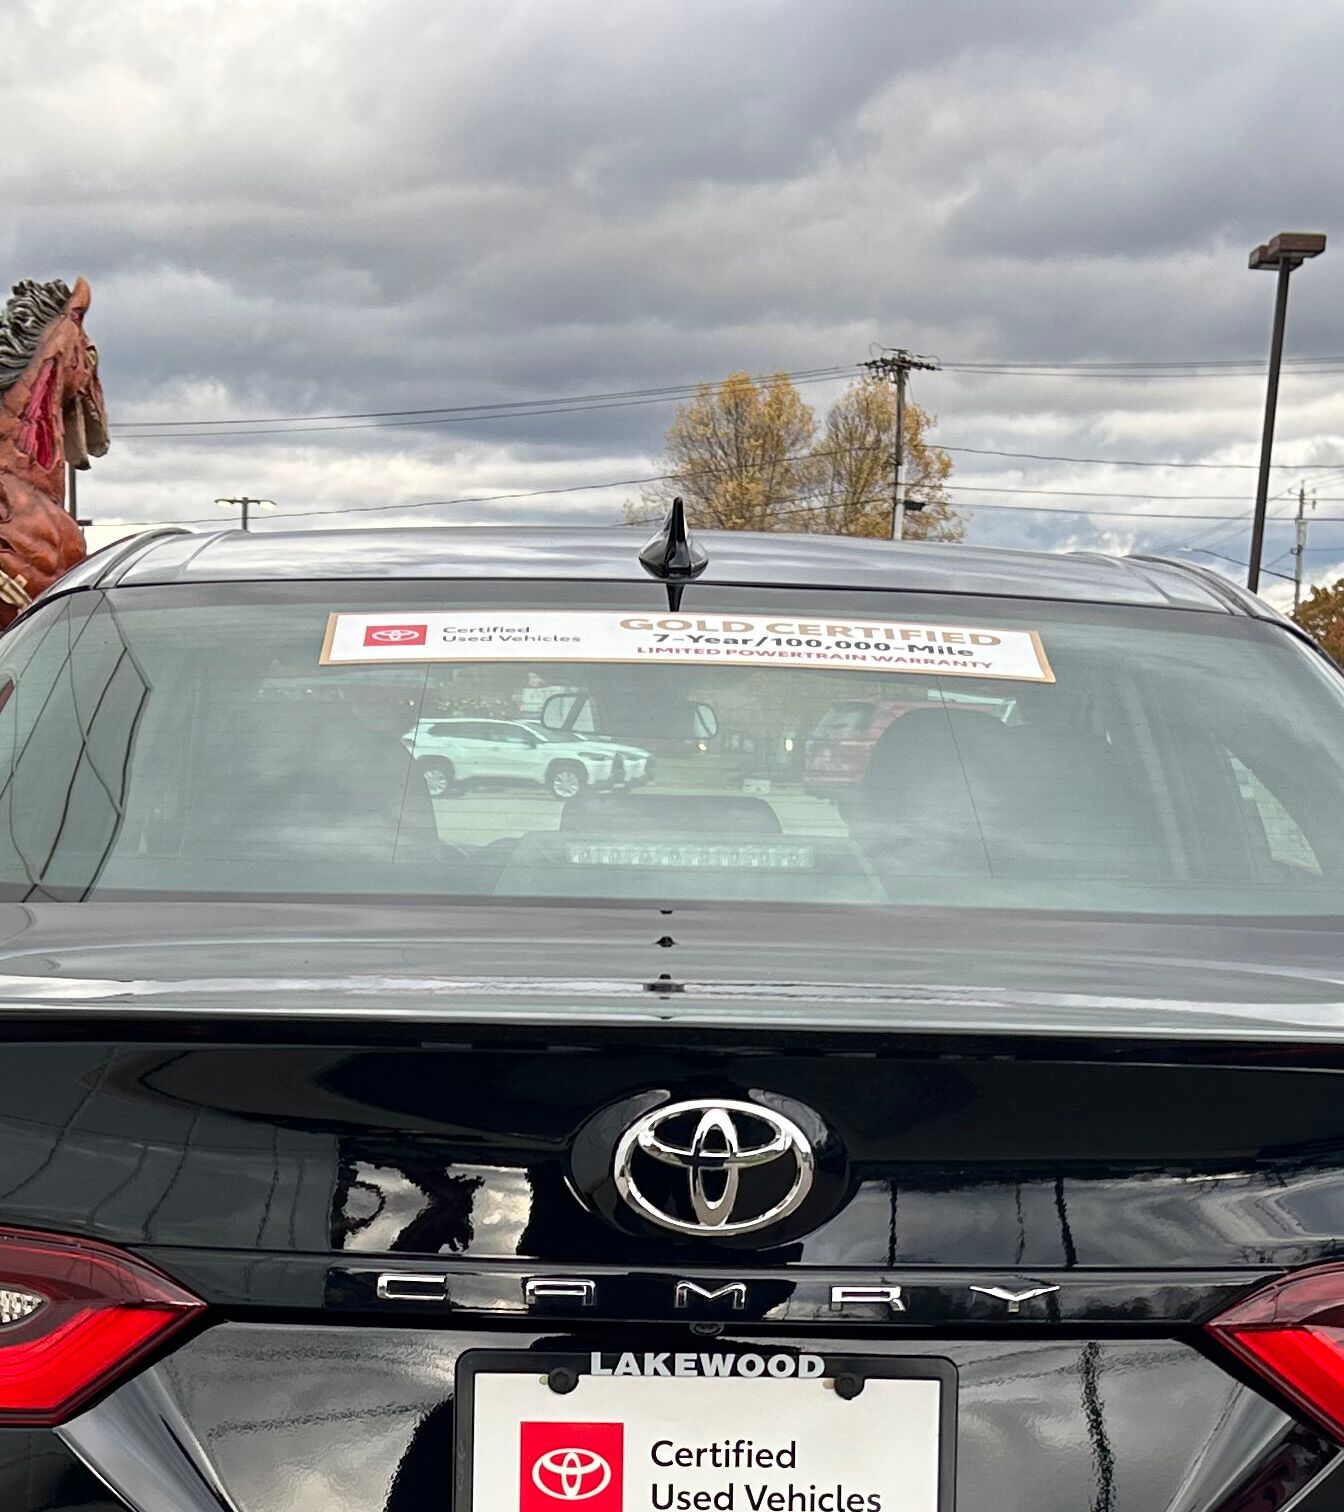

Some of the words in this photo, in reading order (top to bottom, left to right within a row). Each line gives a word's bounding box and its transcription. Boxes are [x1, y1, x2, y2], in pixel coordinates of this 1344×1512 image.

[442, 625, 531, 634] Certified
[442, 635, 494, 643] Used
[505, 635, 582, 643] Vehicles
[619, 618, 754, 633] GOLD
[765, 623, 1002, 646] CERTIFIED
[637, 647, 721, 656] LIMITED
[725, 650, 867, 661] POWERTRAIN
[871, 655, 993, 669] WARRANTY
[653, 634, 974, 657] 7-Year/100,000-Mile
[377, 1273, 1060, 1312] CAMRY
[590, 1351, 826, 1380] LAKEWOOD
[650, 1440, 797, 1470] Certified
[650, 1484, 734, 1512] Used
